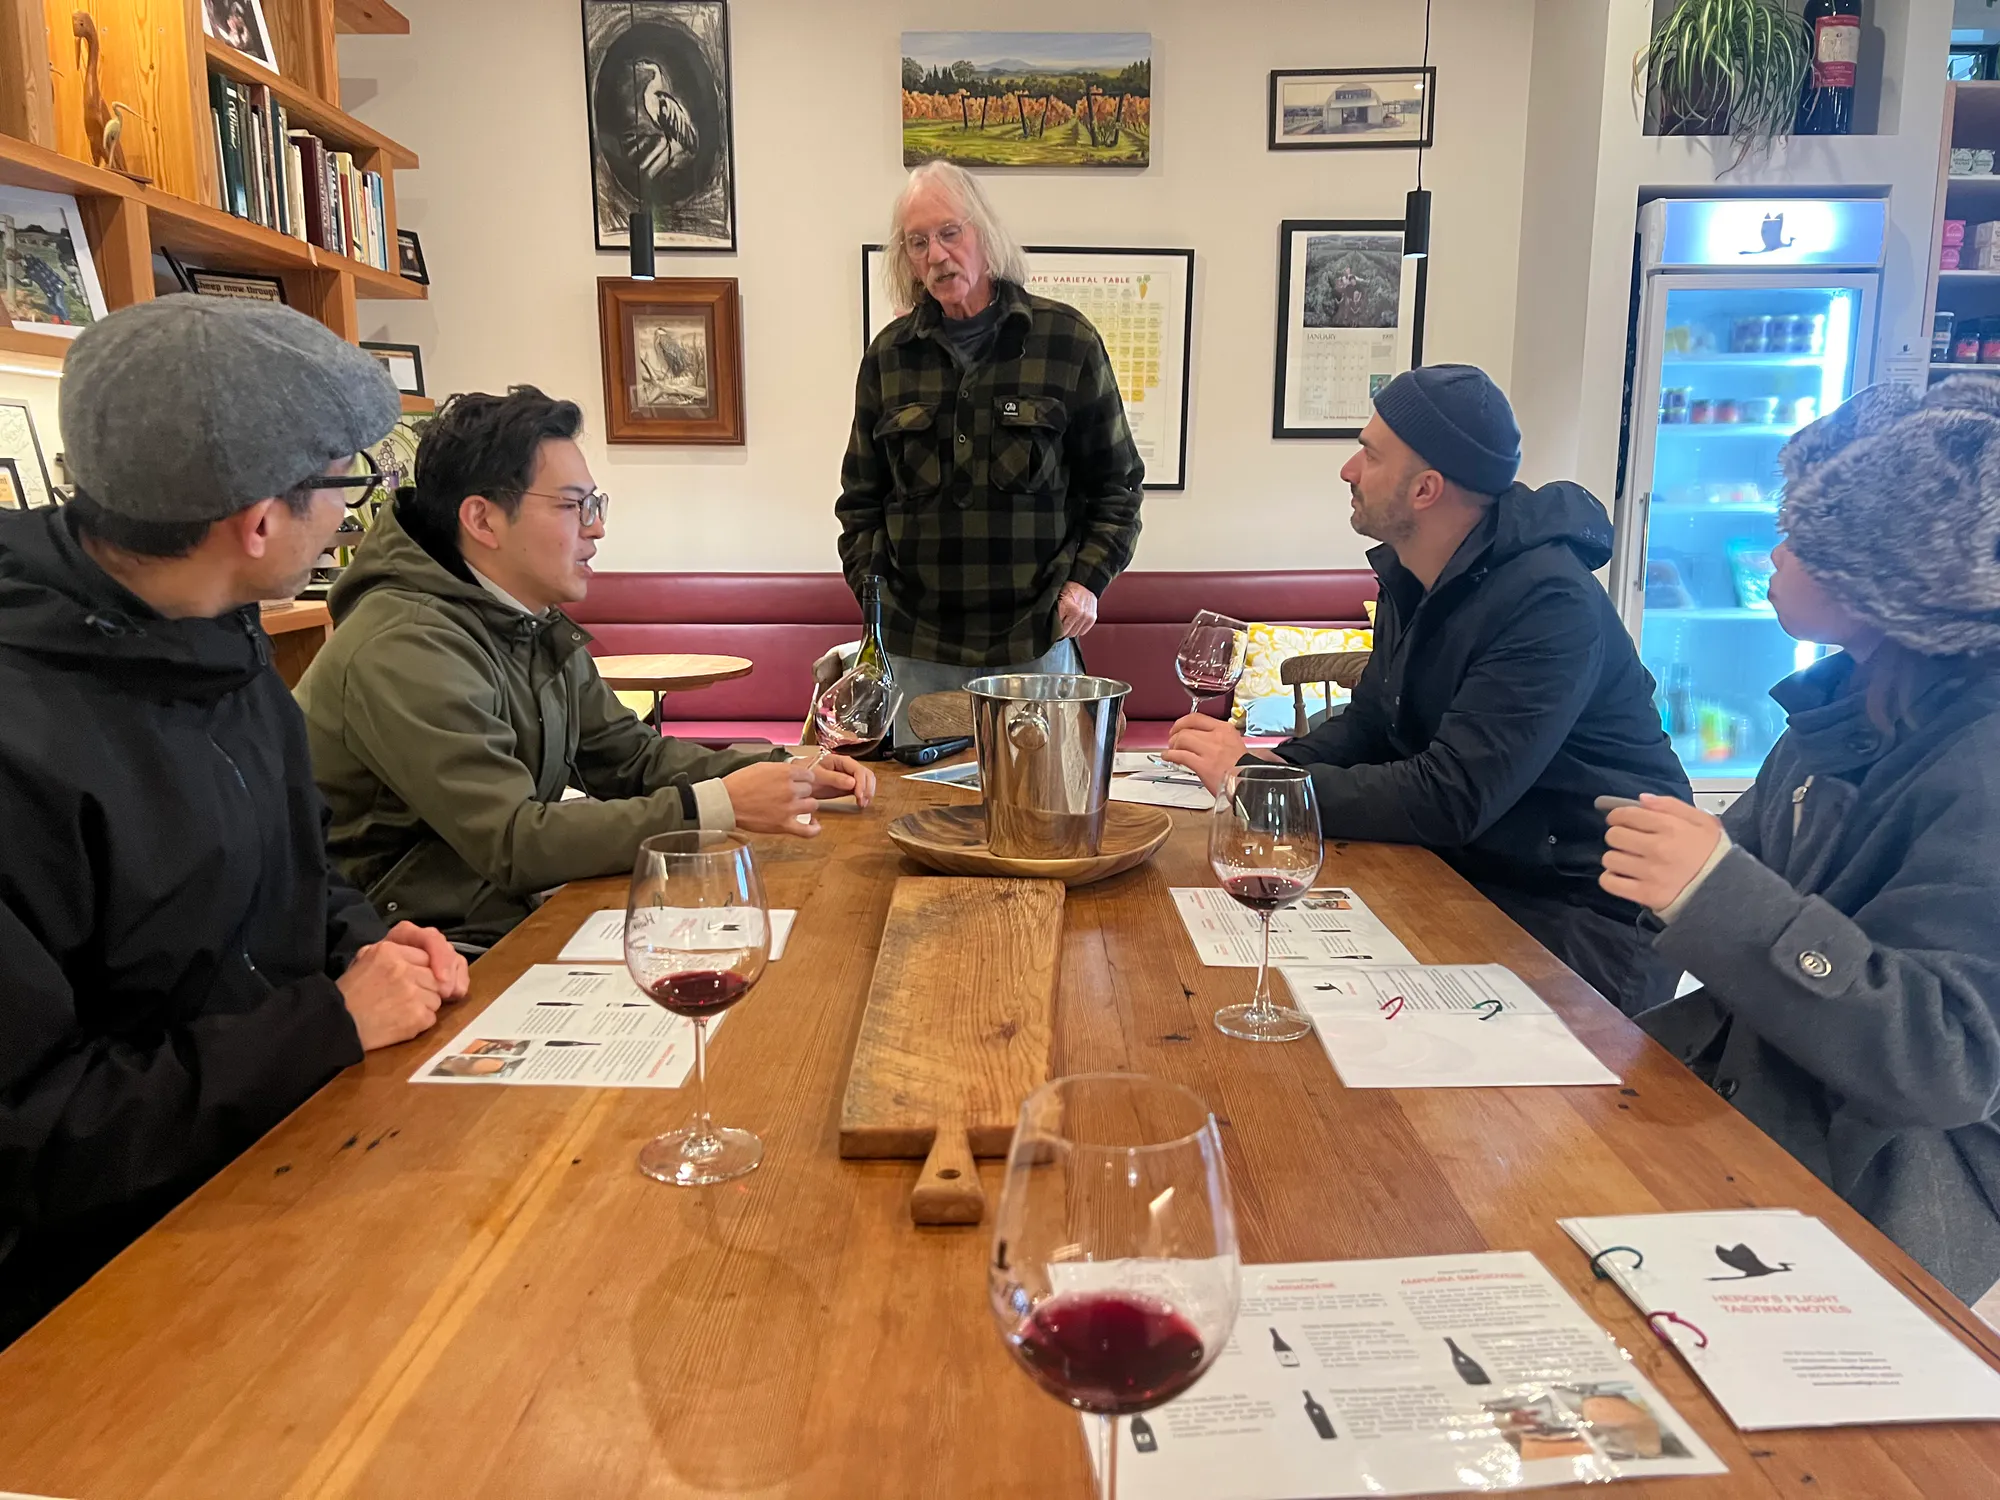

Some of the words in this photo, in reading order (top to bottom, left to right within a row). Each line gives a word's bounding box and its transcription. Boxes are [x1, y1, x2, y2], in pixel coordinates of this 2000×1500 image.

[1053, 276, 1098, 284] VARIETAL
[1103, 276, 1131, 284] TABLE
[246, 285, 279, 298] through
[1712, 1294, 1783, 1304] HERON'S
[1784, 1294, 1840, 1304] FLIGHT
[1720, 1304, 1792, 1314] TASTING
[1794, 1304, 1852, 1314] NOTES
